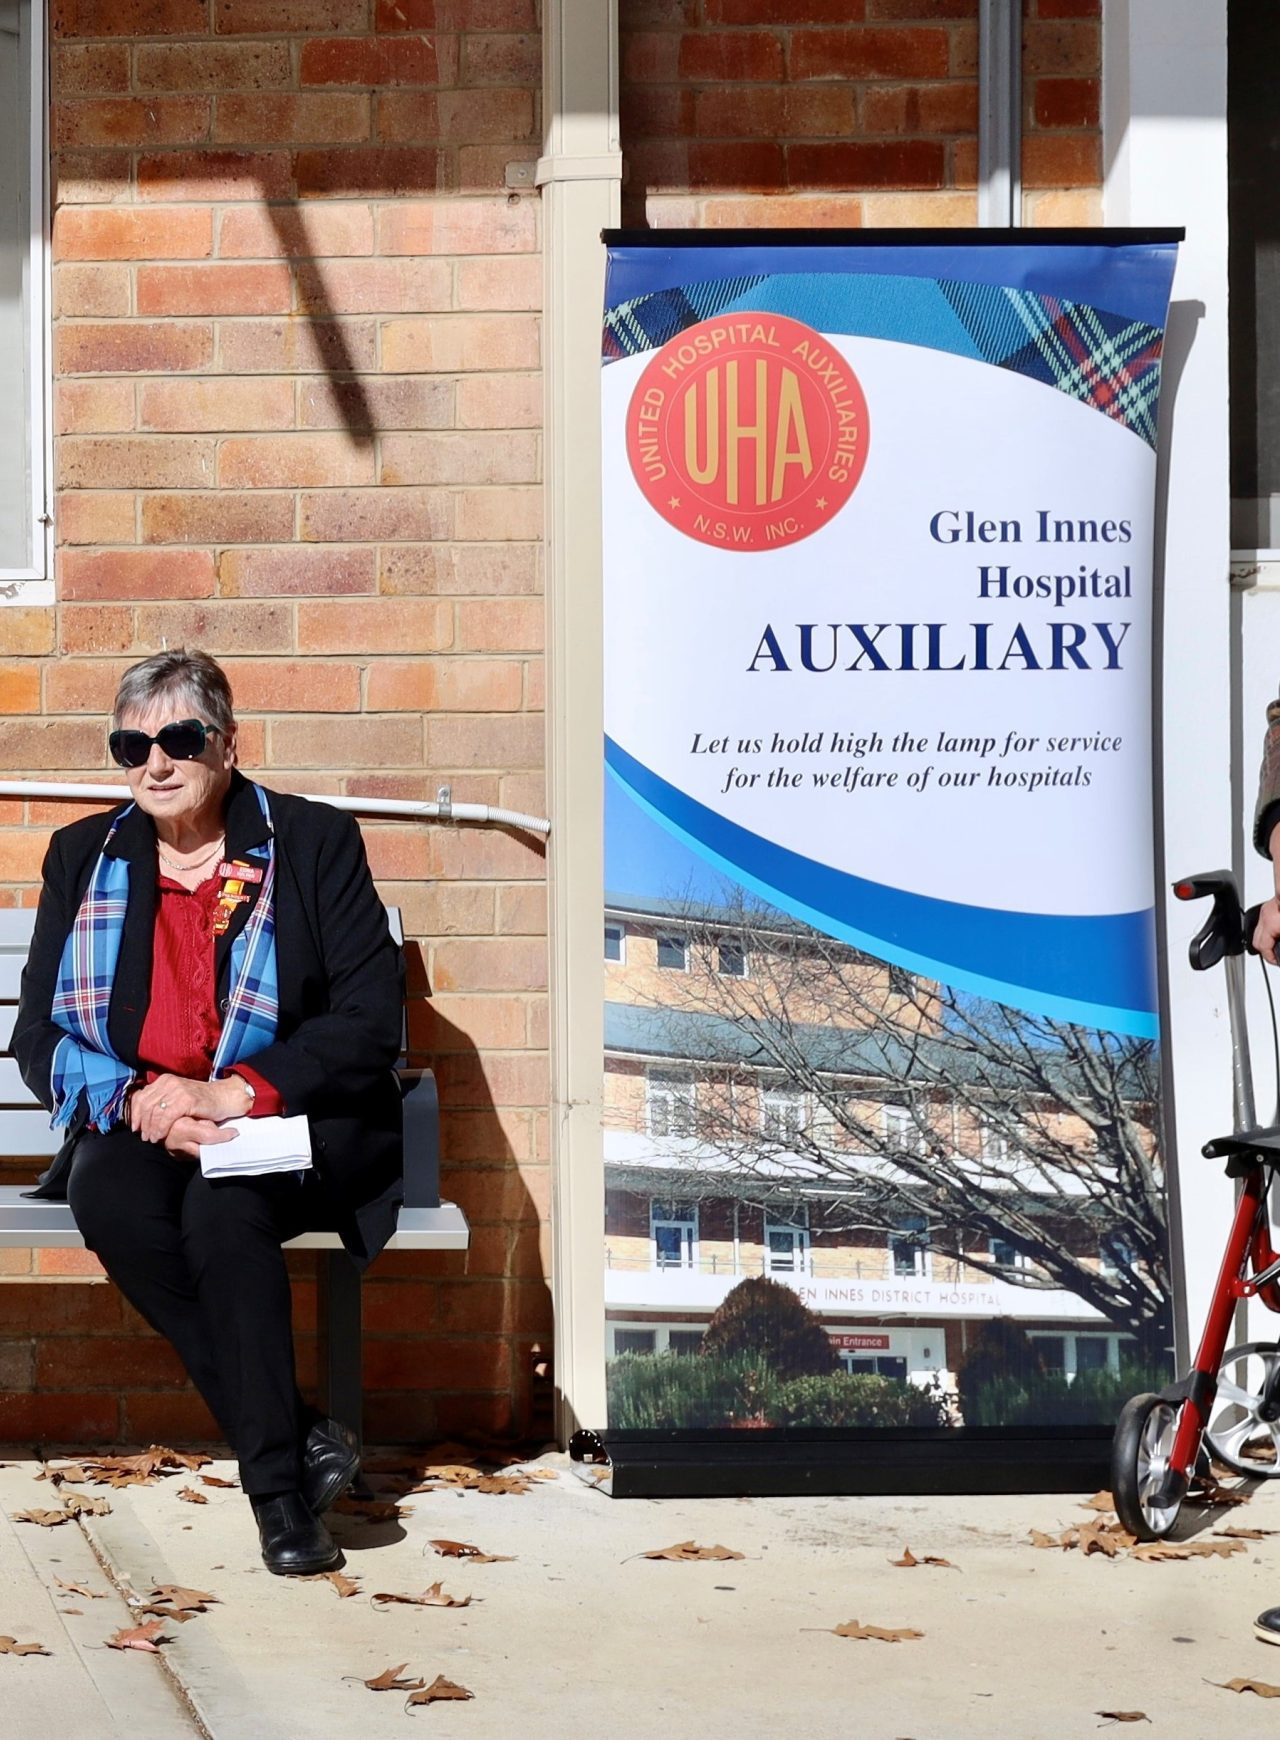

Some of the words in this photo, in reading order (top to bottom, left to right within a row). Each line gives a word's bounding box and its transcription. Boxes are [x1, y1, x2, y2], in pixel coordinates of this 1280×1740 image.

[639, 387, 667, 482] UNITED
[662, 324, 780, 379] HOSPITAL
[792, 340, 858, 483] AUXILIARIES
[685, 359, 813, 506] UHA
[693, 514, 754, 543] N.S.W.
[765, 517, 805, 541] INC.
[929, 510, 1023, 544] Glen
[1035, 510, 1132, 544] Innes
[977, 565, 1132, 607] Hospital
[746, 622, 1132, 672] AUXILIARY
[690, 733, 730, 754] Let
[737, 739, 763, 753] us
[770, 732, 824, 753] hold
[830, 732, 884, 758] high
[892, 732, 928, 753] the
[936, 732, 996, 758] lamp
[999, 731, 1040, 758] for
[1046, 731, 1122, 752] service
[721, 767, 761, 793] for
[767, 767, 803, 788] the
[812, 766, 899, 792] welfare
[906, 766, 934, 792] of
[938, 771, 981, 787] our
[987, 765, 1092, 792] hospitals
[799, 1287, 817, 1300] EN
[825, 1288, 864, 1301] INNES
[872, 1289, 930, 1303] DISTRICT
[939, 1291, 1001, 1306] HOSPITAL
[843, 1336, 882, 1347] Entrance
